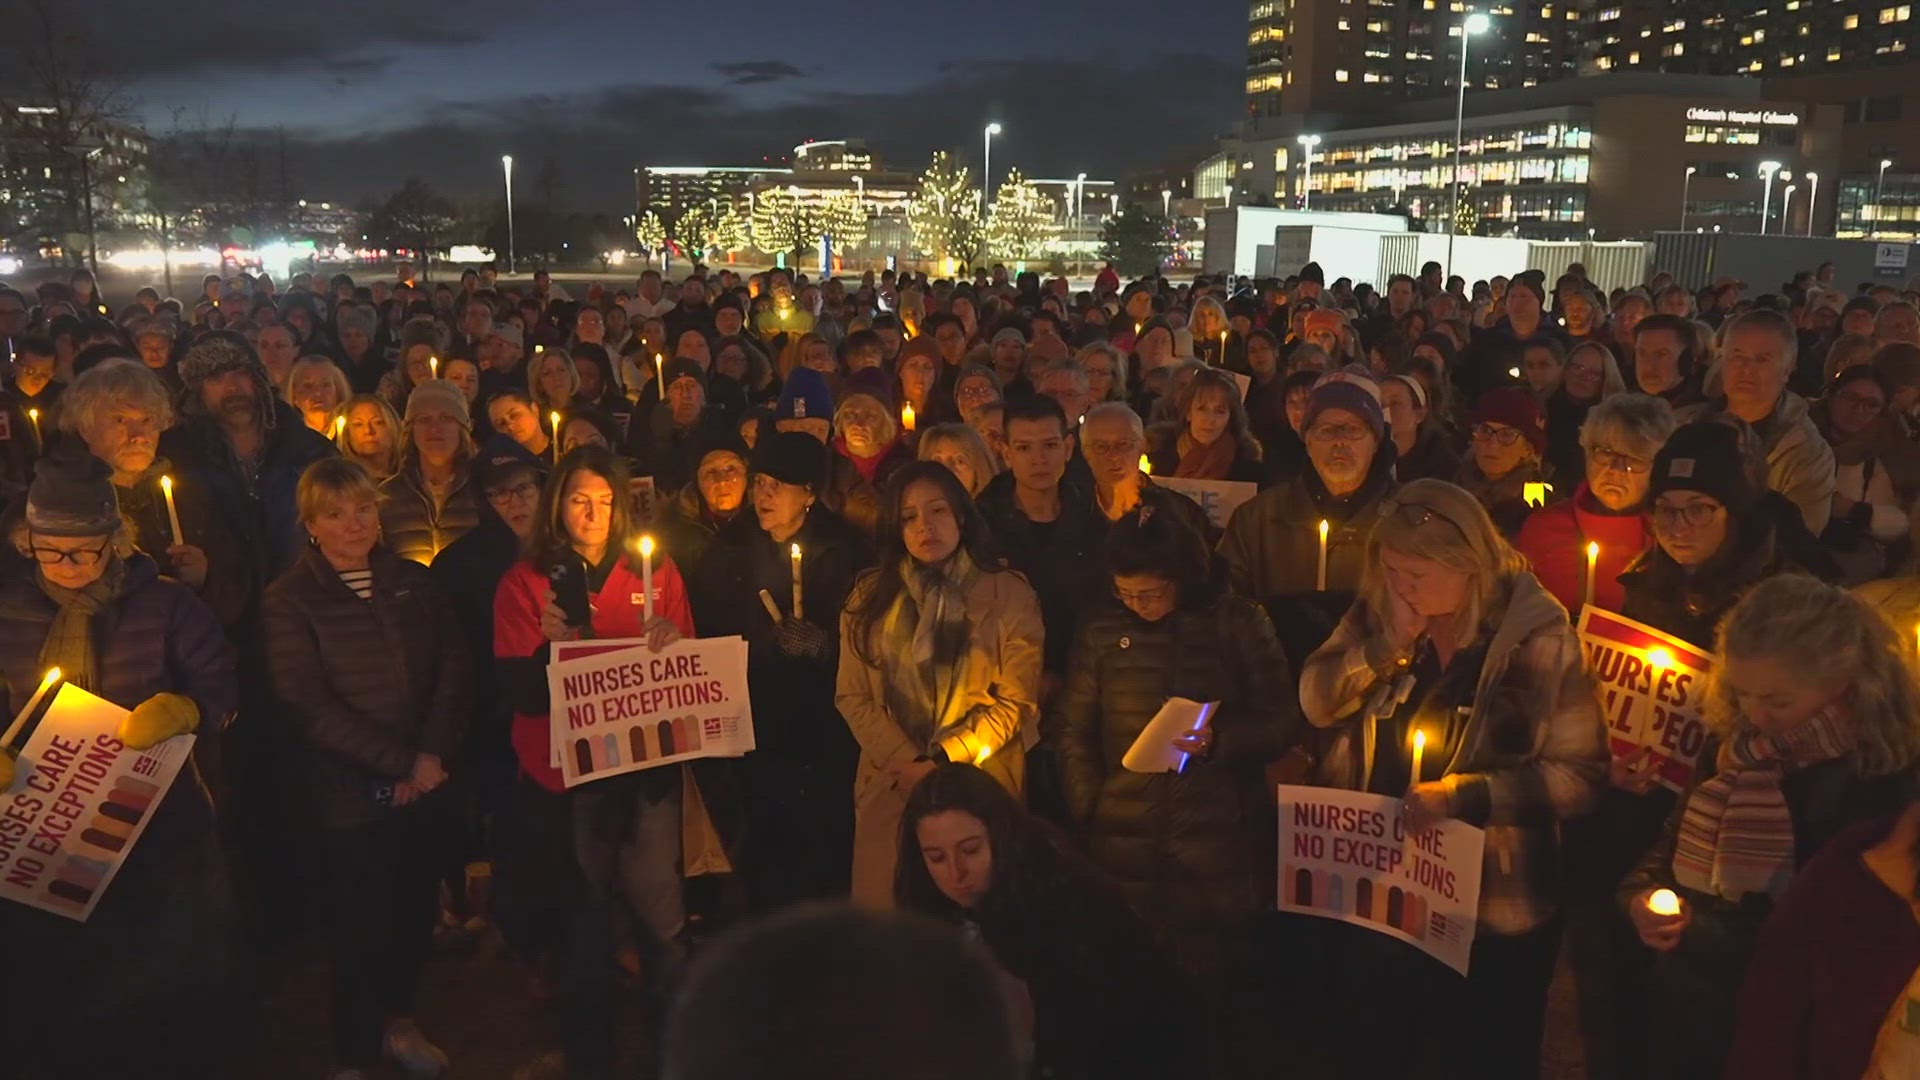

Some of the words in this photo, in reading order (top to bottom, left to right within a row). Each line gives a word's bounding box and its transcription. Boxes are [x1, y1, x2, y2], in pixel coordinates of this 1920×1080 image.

[563, 663, 644, 700] NURSES
[651, 654, 708, 683] CARE.
[568, 702, 596, 730] NO
[602, 680, 729, 722] EXCEPTIONS.
[26, 734, 85, 793] CARE.
[1294, 802, 1385, 839] NURSES
[1294, 833, 1324, 859] NO
[5, 856, 45, 888] NO
